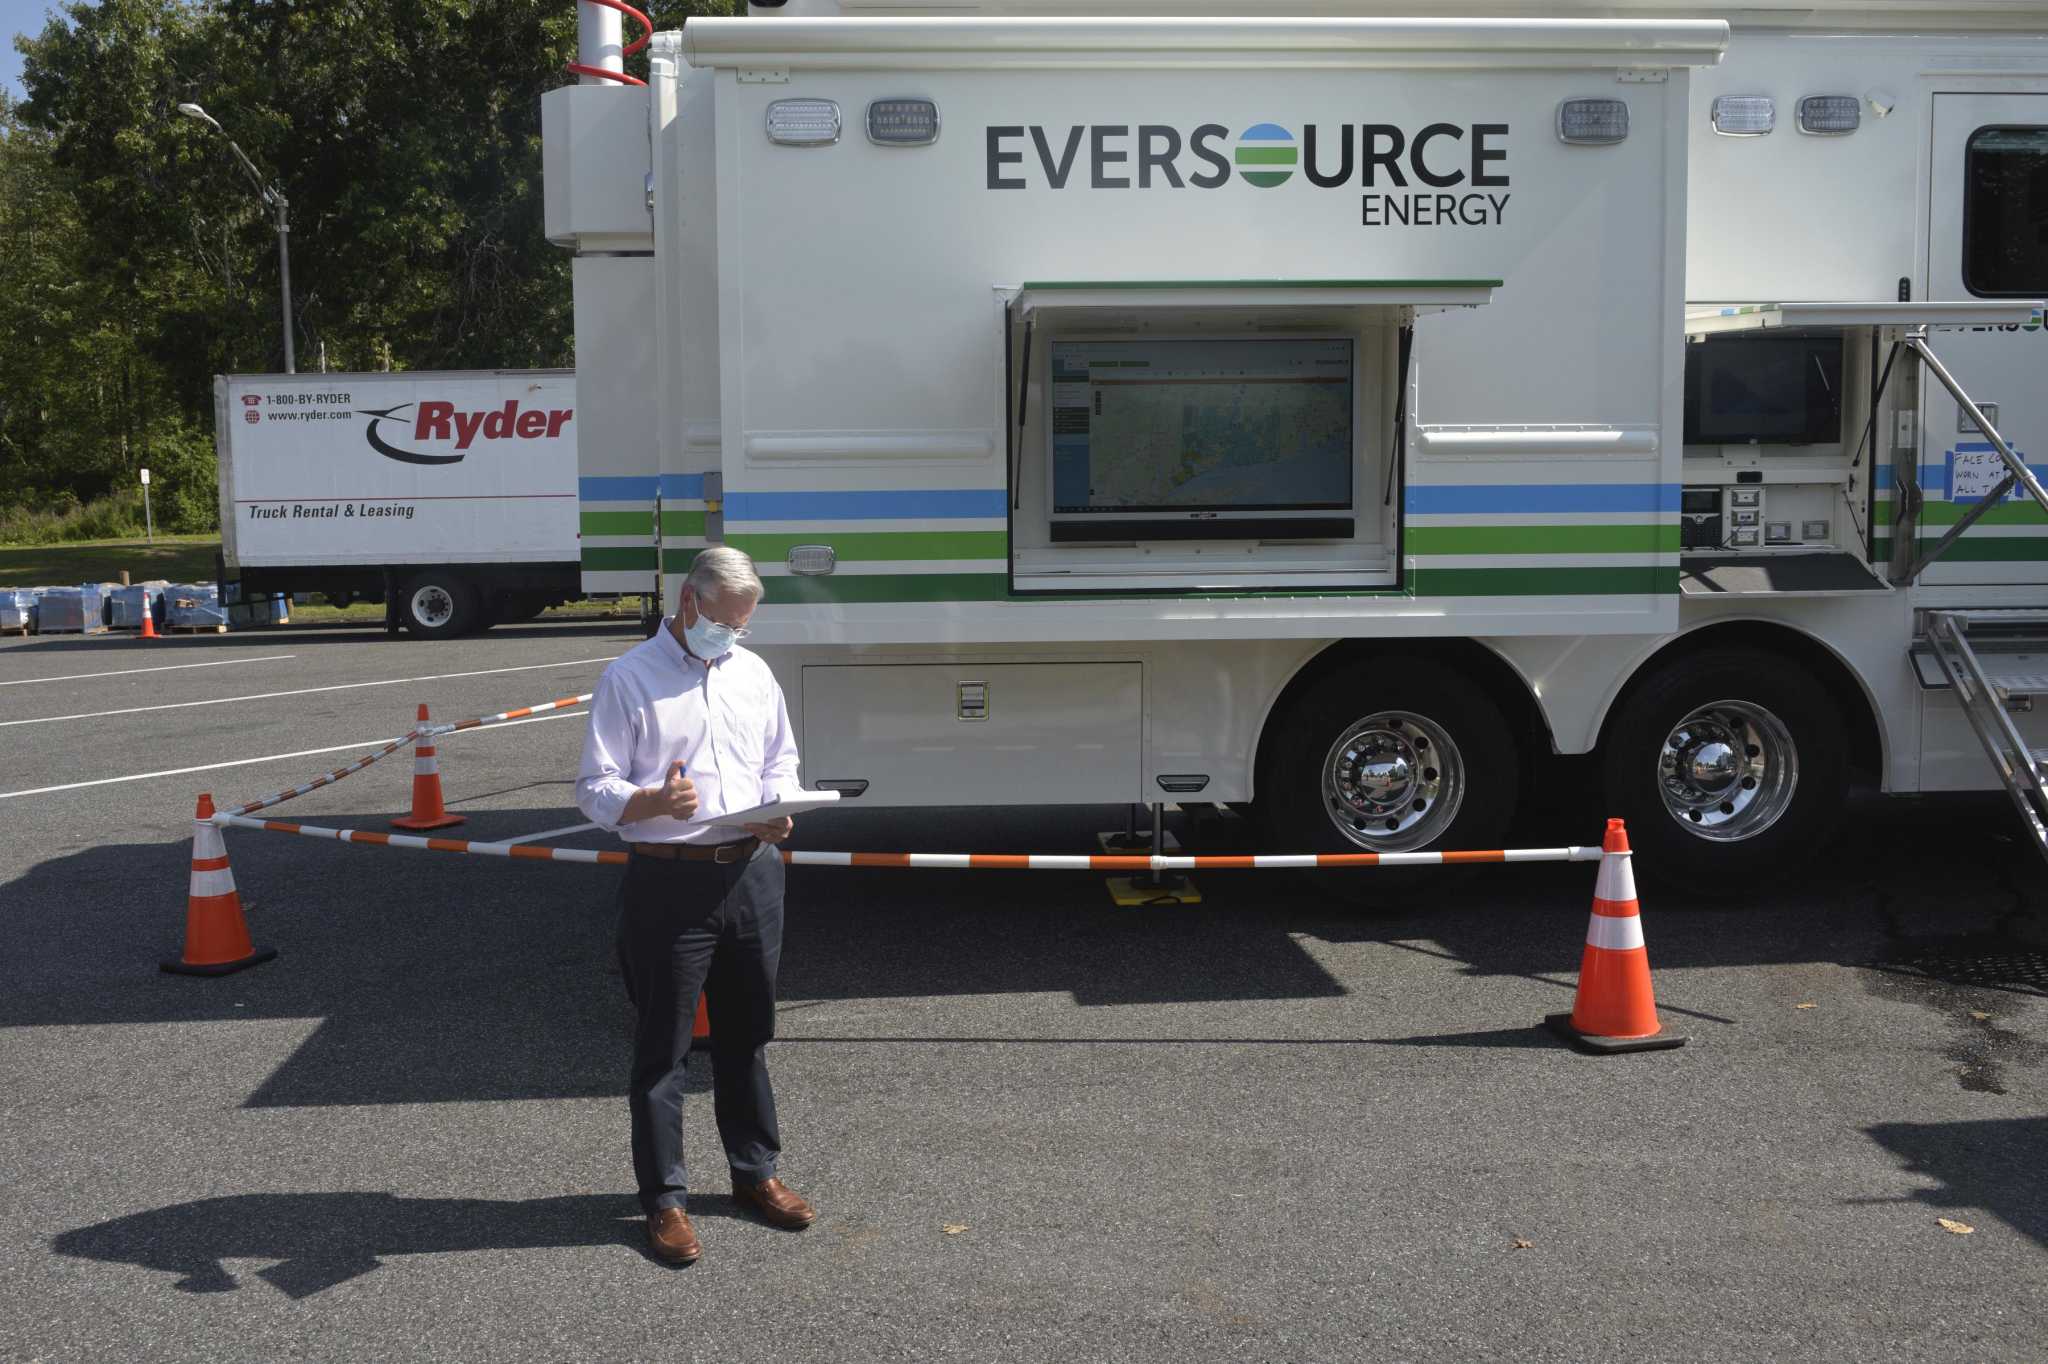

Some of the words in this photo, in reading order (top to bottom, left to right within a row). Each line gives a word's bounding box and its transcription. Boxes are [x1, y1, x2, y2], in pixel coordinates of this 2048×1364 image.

[1362, 194, 1511, 226] ENERGY
[266, 393, 351, 405] 1-800-BY-RYDER
[267, 410, 352, 422] www.ryder.com
[415, 400, 573, 449] Ryder
[249, 505, 288, 519] Truck
[292, 504, 339, 518] Rental
[343, 503, 355, 517] &
[359, 503, 415, 519] Leasing
